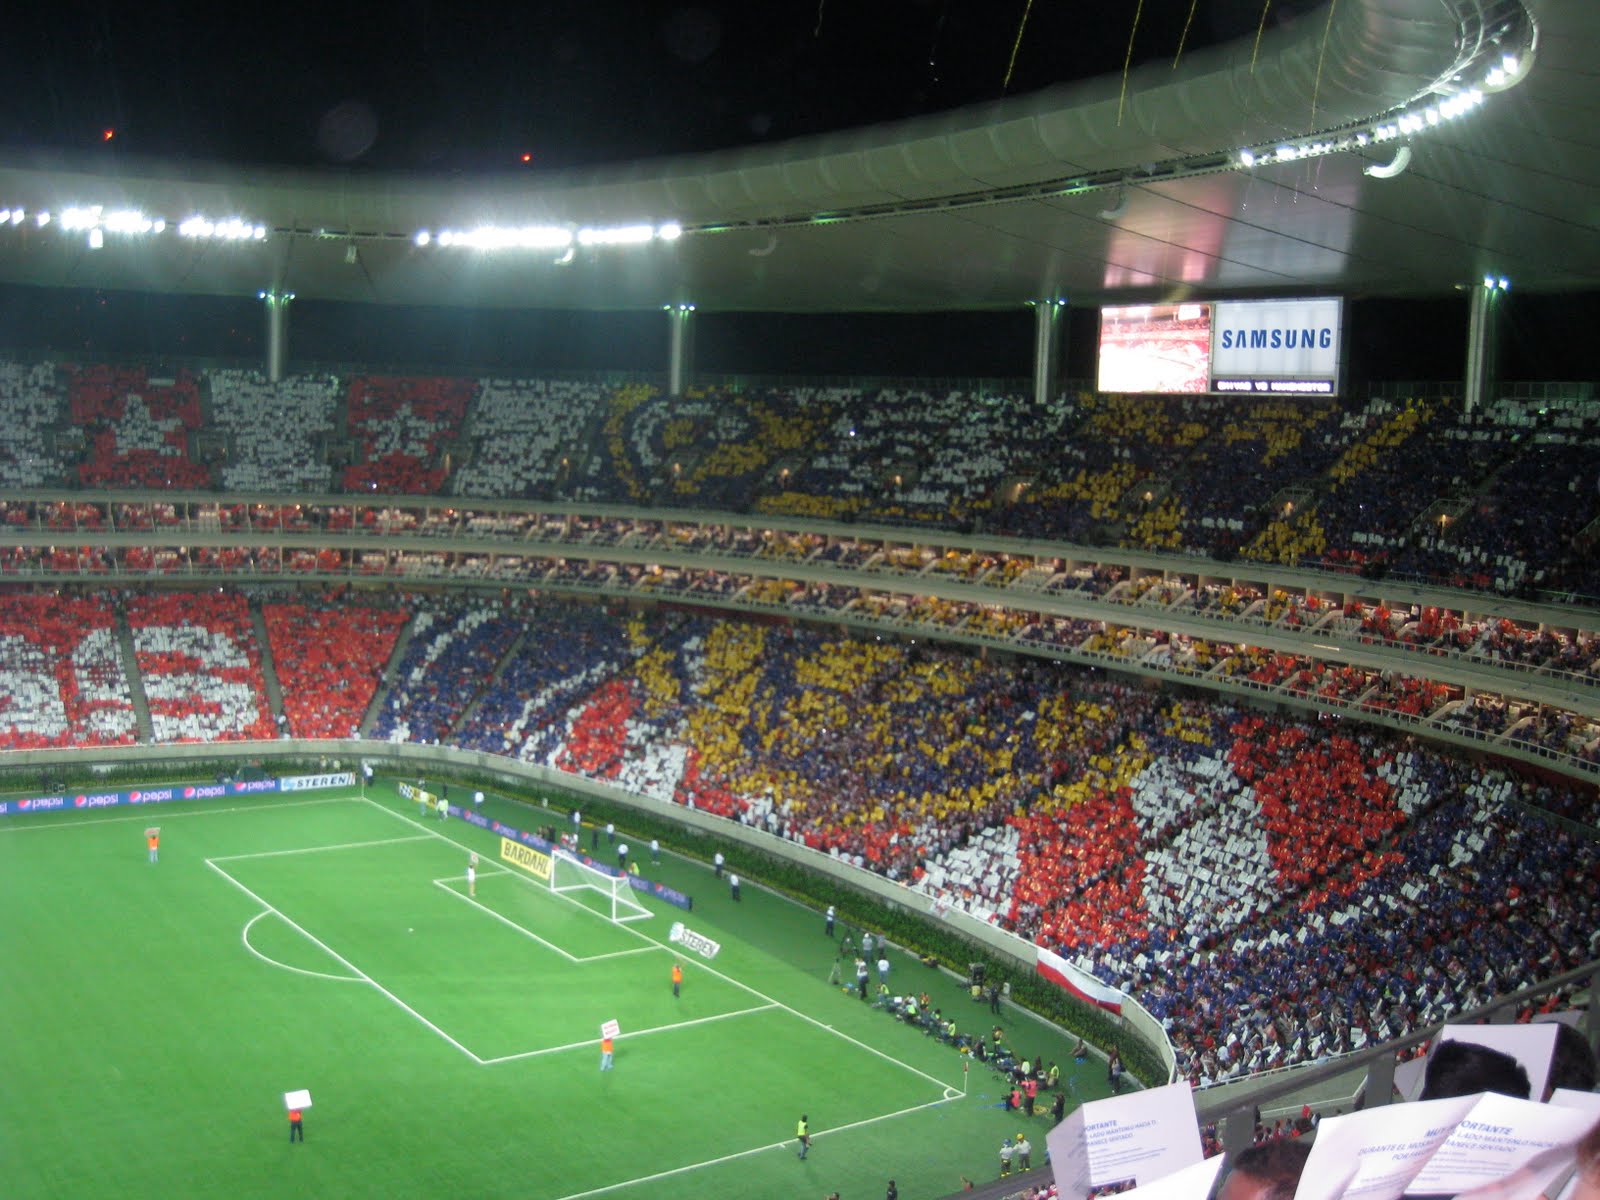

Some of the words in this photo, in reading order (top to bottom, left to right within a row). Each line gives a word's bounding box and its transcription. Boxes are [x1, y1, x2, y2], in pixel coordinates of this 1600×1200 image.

[1221, 327, 1331, 349] SAMSUNG
[247, 779, 276, 791] pepsi
[296, 775, 347, 787] STEREN
[142, 789, 173, 803] pepsi
[196, 785, 226, 798] pepsi
[32, 796, 64, 810] pepsi
[88, 793, 119, 807] pepsi
[503, 842, 549, 875] BARDAHL
[679, 930, 717, 956] STEREN
[1084, 1120, 1117, 1132] PORTANTE
[1460, 1120, 1513, 1136] ORTANTE
